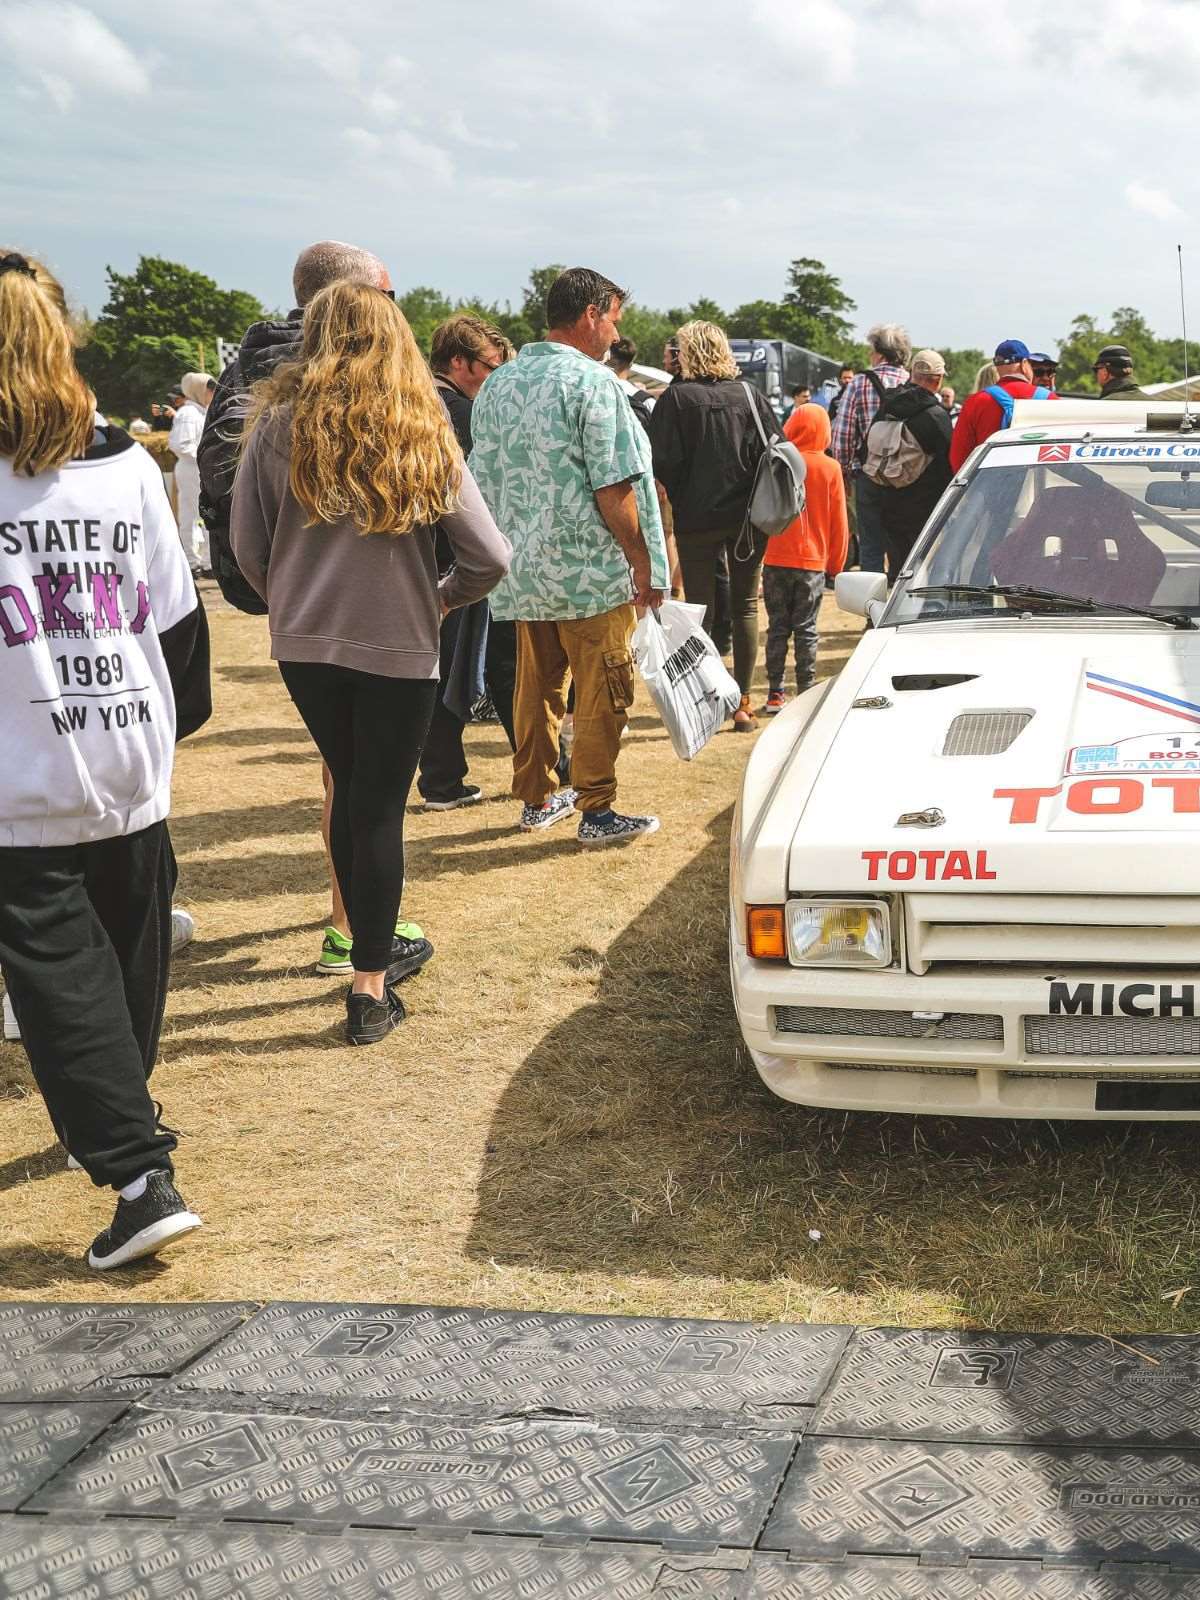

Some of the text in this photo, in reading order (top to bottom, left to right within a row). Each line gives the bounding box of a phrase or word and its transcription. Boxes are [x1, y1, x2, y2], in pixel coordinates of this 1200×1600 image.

[1075, 445, 1161, 457] Citroën
[0, 519, 141, 556] STATE OF
[56, 653, 124, 687] 1989
[98, 700, 152, 731] YORK
[861, 850, 997, 881] TOTAL
[366, 1456, 411, 1471] DOG
[415, 1460, 489, 1475] GUARD
[1079, 1493, 1124, 1505] DOG
